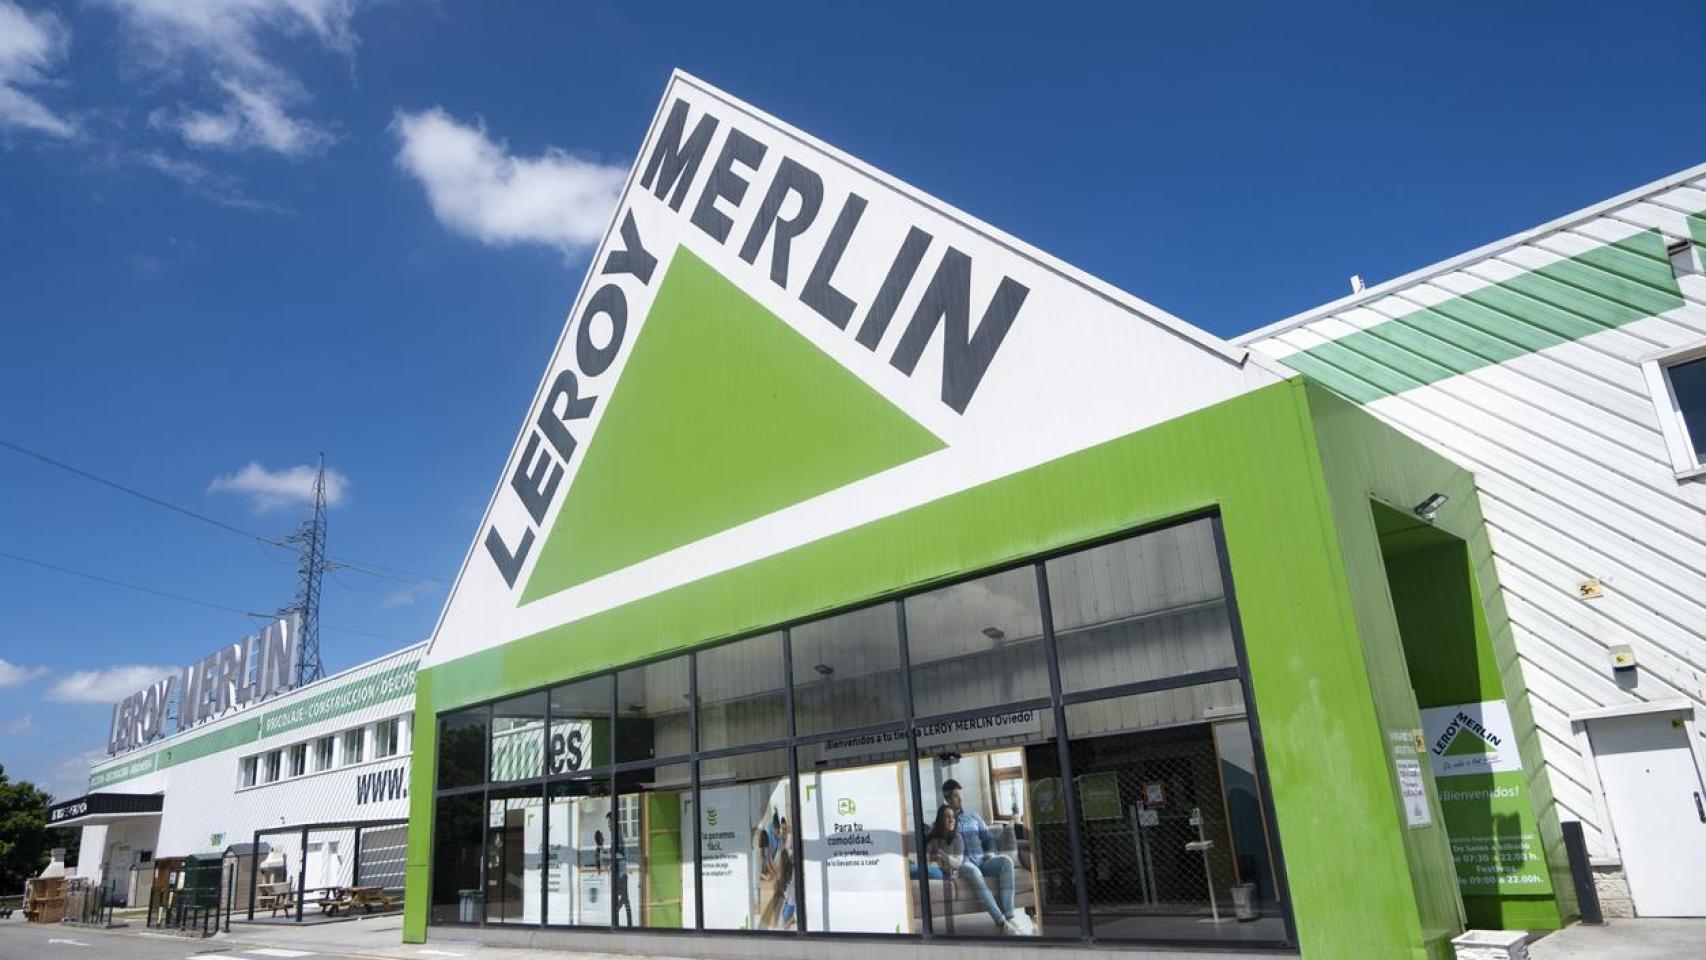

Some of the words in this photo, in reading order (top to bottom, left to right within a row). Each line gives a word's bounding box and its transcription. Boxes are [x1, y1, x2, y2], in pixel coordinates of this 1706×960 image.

[484, 208, 658, 590] LEROY
[640, 97, 1030, 415] MERLIN
[108, 675, 177, 755] LEROY
[178, 612, 300, 731] MERLIN
[883, 733, 892, 742] tu
[894, 727, 921, 741] tiea
[924, 723, 953, 737] LEROY
[955, 717, 993, 732] MERLIN
[996, 709, 1034, 726] Oviedo!
[1432, 718, 1461, 756] LEROY
[1456, 711, 1502, 746] MERLIN
[828, 833, 873, 846] comodidad,
[834, 823, 852, 832] Para
[853, 822, 863, 832] tu
